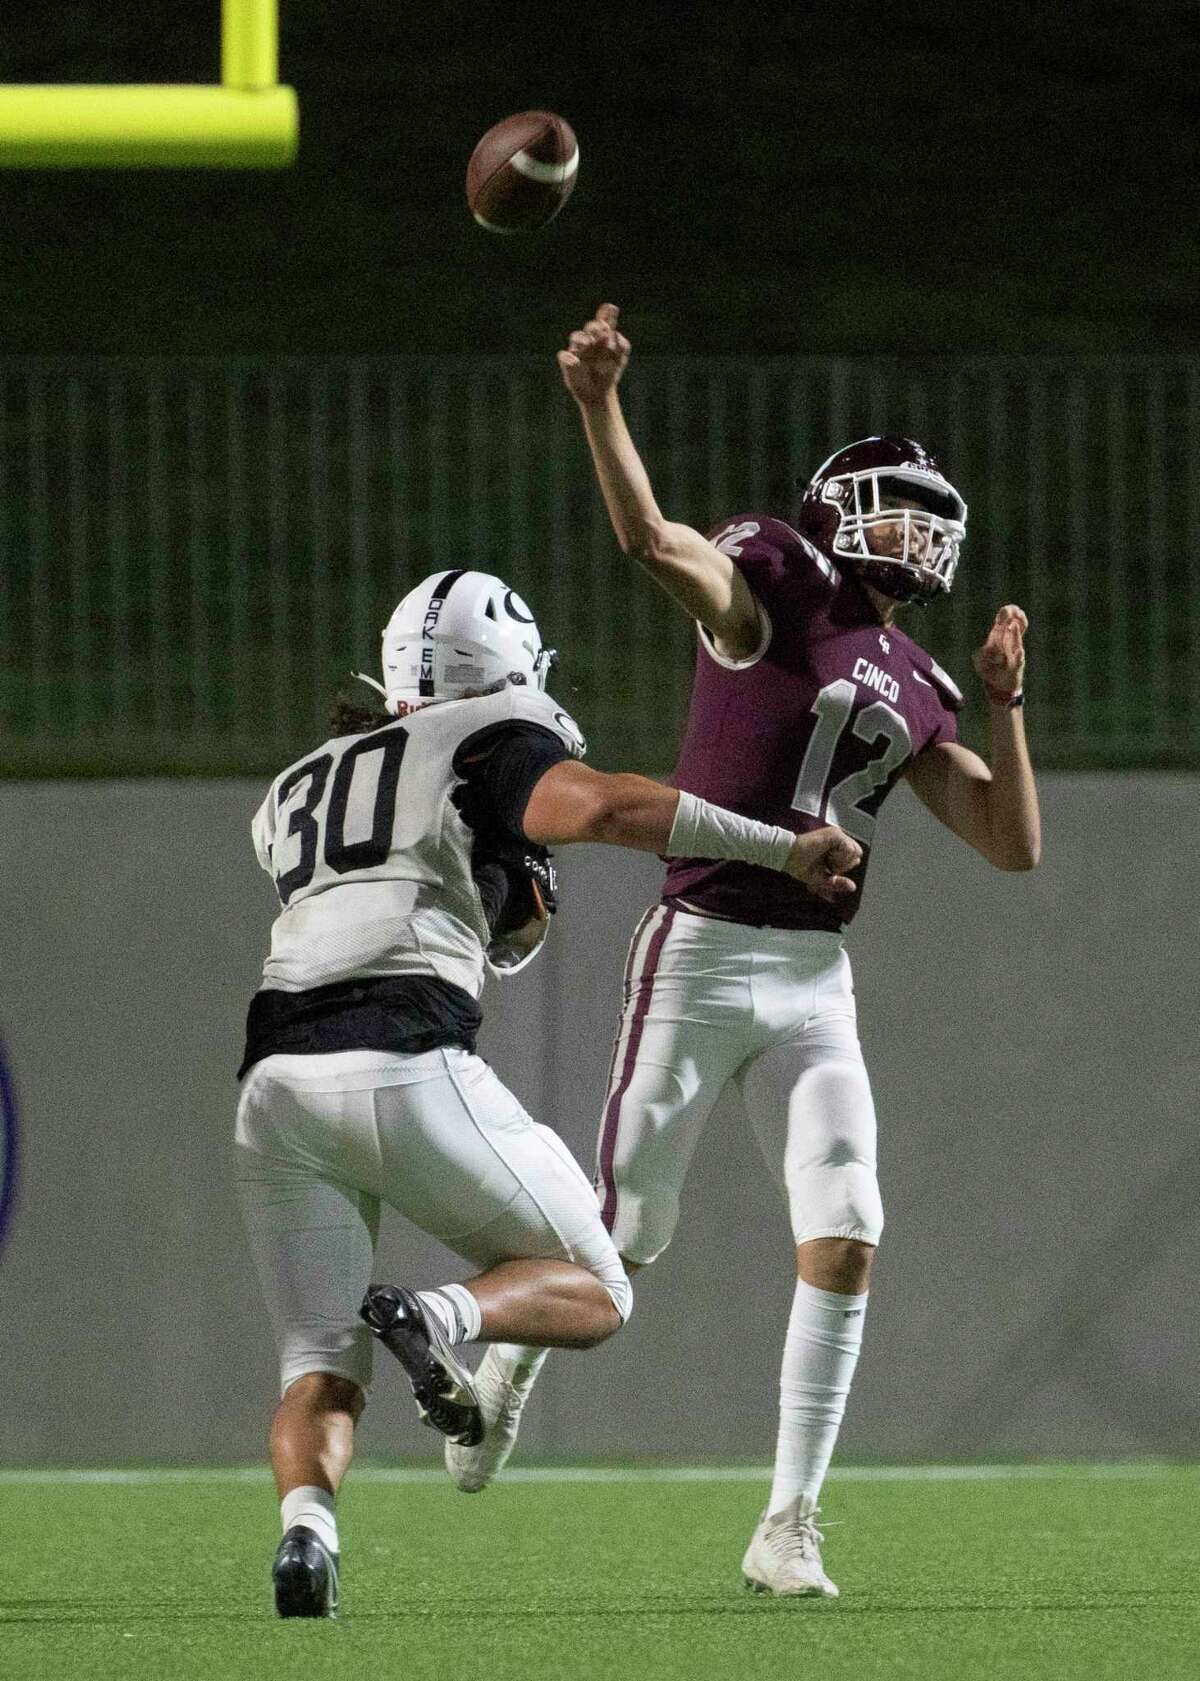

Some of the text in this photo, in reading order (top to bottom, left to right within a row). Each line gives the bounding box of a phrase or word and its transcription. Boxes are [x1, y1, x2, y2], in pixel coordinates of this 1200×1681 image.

[420, 599, 443, 679] OAK EM
[852, 657, 900, 703] CINCO
[268, 726, 410, 905] 30
[791, 678, 912, 847] 12
